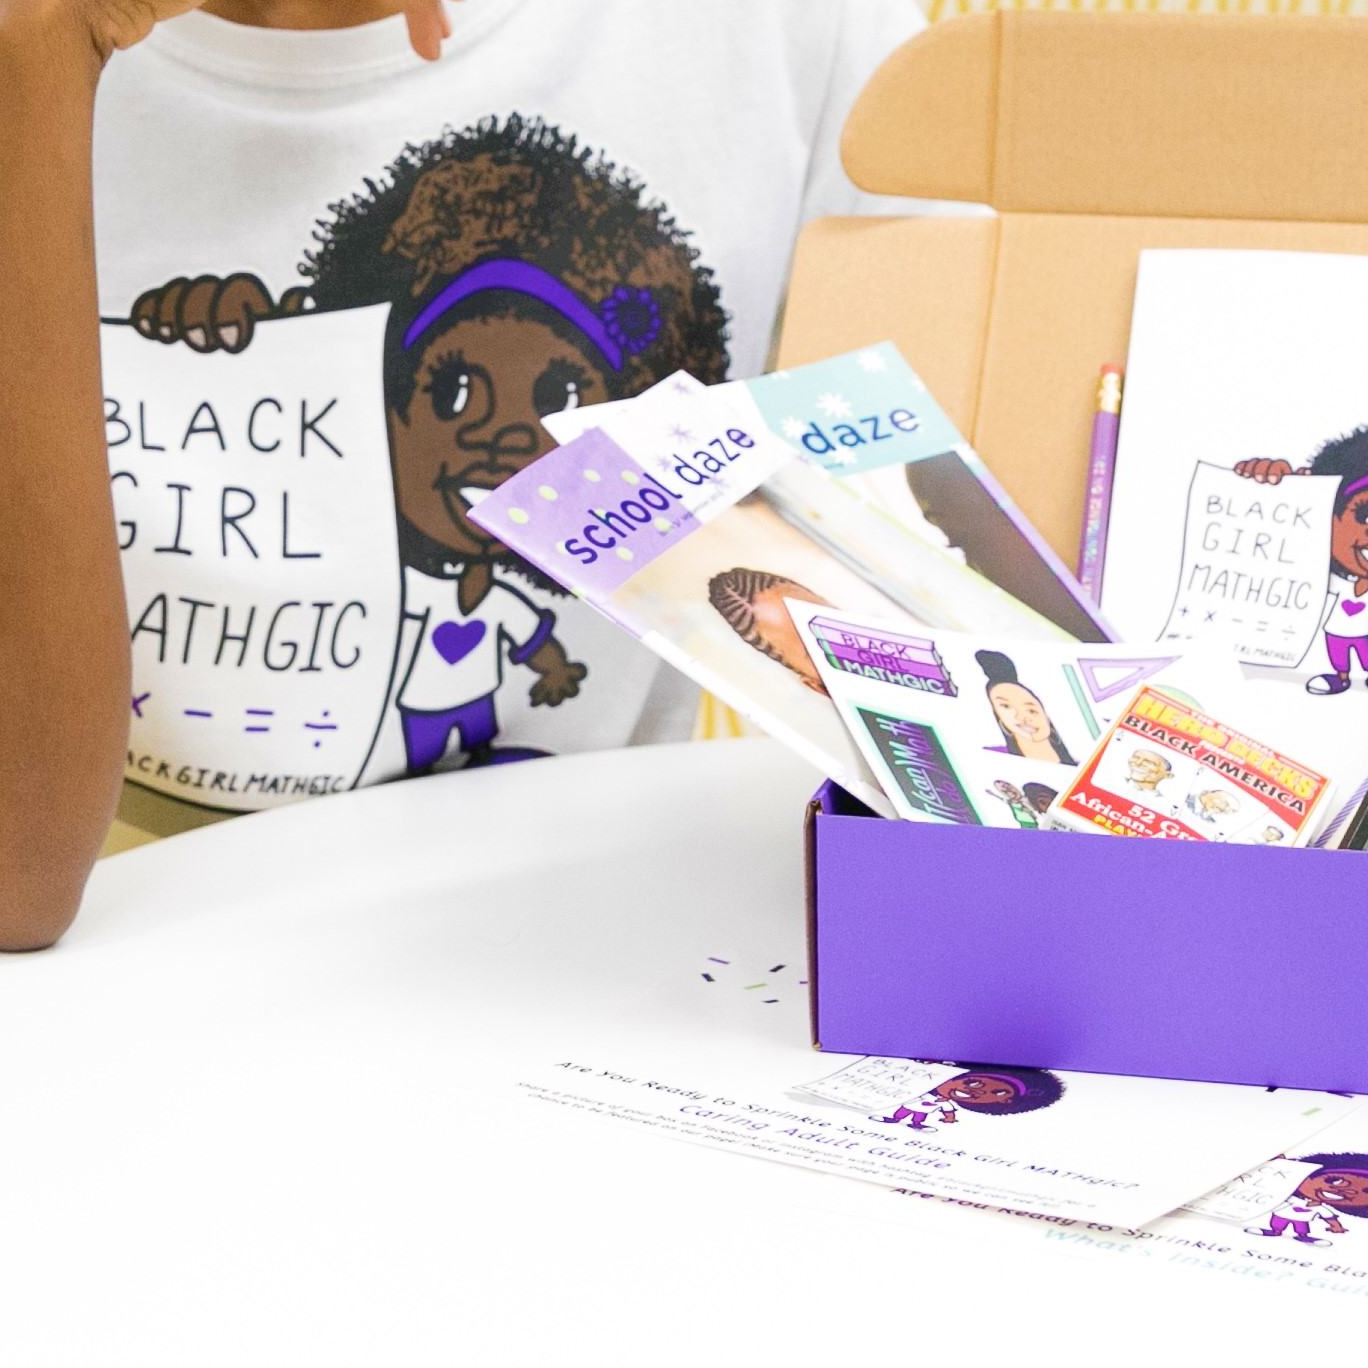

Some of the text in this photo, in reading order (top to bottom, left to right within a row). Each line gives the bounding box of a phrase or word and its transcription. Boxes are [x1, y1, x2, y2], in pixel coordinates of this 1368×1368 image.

[800, 408, 922, 456] daze
[564, 473, 682, 565] school
[674, 427, 756, 487] daze
[1206, 495, 1313, 529] BLACK
[1202, 522, 1296, 564] GIRL
[1188, 564, 1312, 611] MATHGIC
[131, 593, 366, 673] ATHGIC
[840, 633, 911, 660] BLACK
[843, 659, 944, 694] MATHGIC
[857, 651, 910, 673] GIRL
[1124, 715, 1305, 813] BLACK AMERICA
[1133, 694, 1318, 800] HERO DECKS
[127, 750, 345, 796] ACKGIRLMATHGIC
[1069, 792, 1167, 839] African-A
[1093, 814, 1145, 838] PLAY
[1128, 805, 1157, 823] 52
[554, 1061, 592, 1073] Are
[596, 1069, 637, 1084] You
[641, 1080, 707, 1101] Ready
[713, 1096, 736, 1106] to
[741, 1103, 832, 1128] Sprinkle
[836, 1125, 898, 1143] Some
[904, 1139, 967, 1157] Black
[973, 1153, 1019, 1168] Girl
[679, 1105, 951, 1169] Caring Adult Guide
[1044, 1228, 1153, 1258] What's
[1167, 1251, 1296, 1281] Inside?
[1121, 1228, 1232, 1254] Sprinkle
[1240, 1248, 1314, 1269] Some
